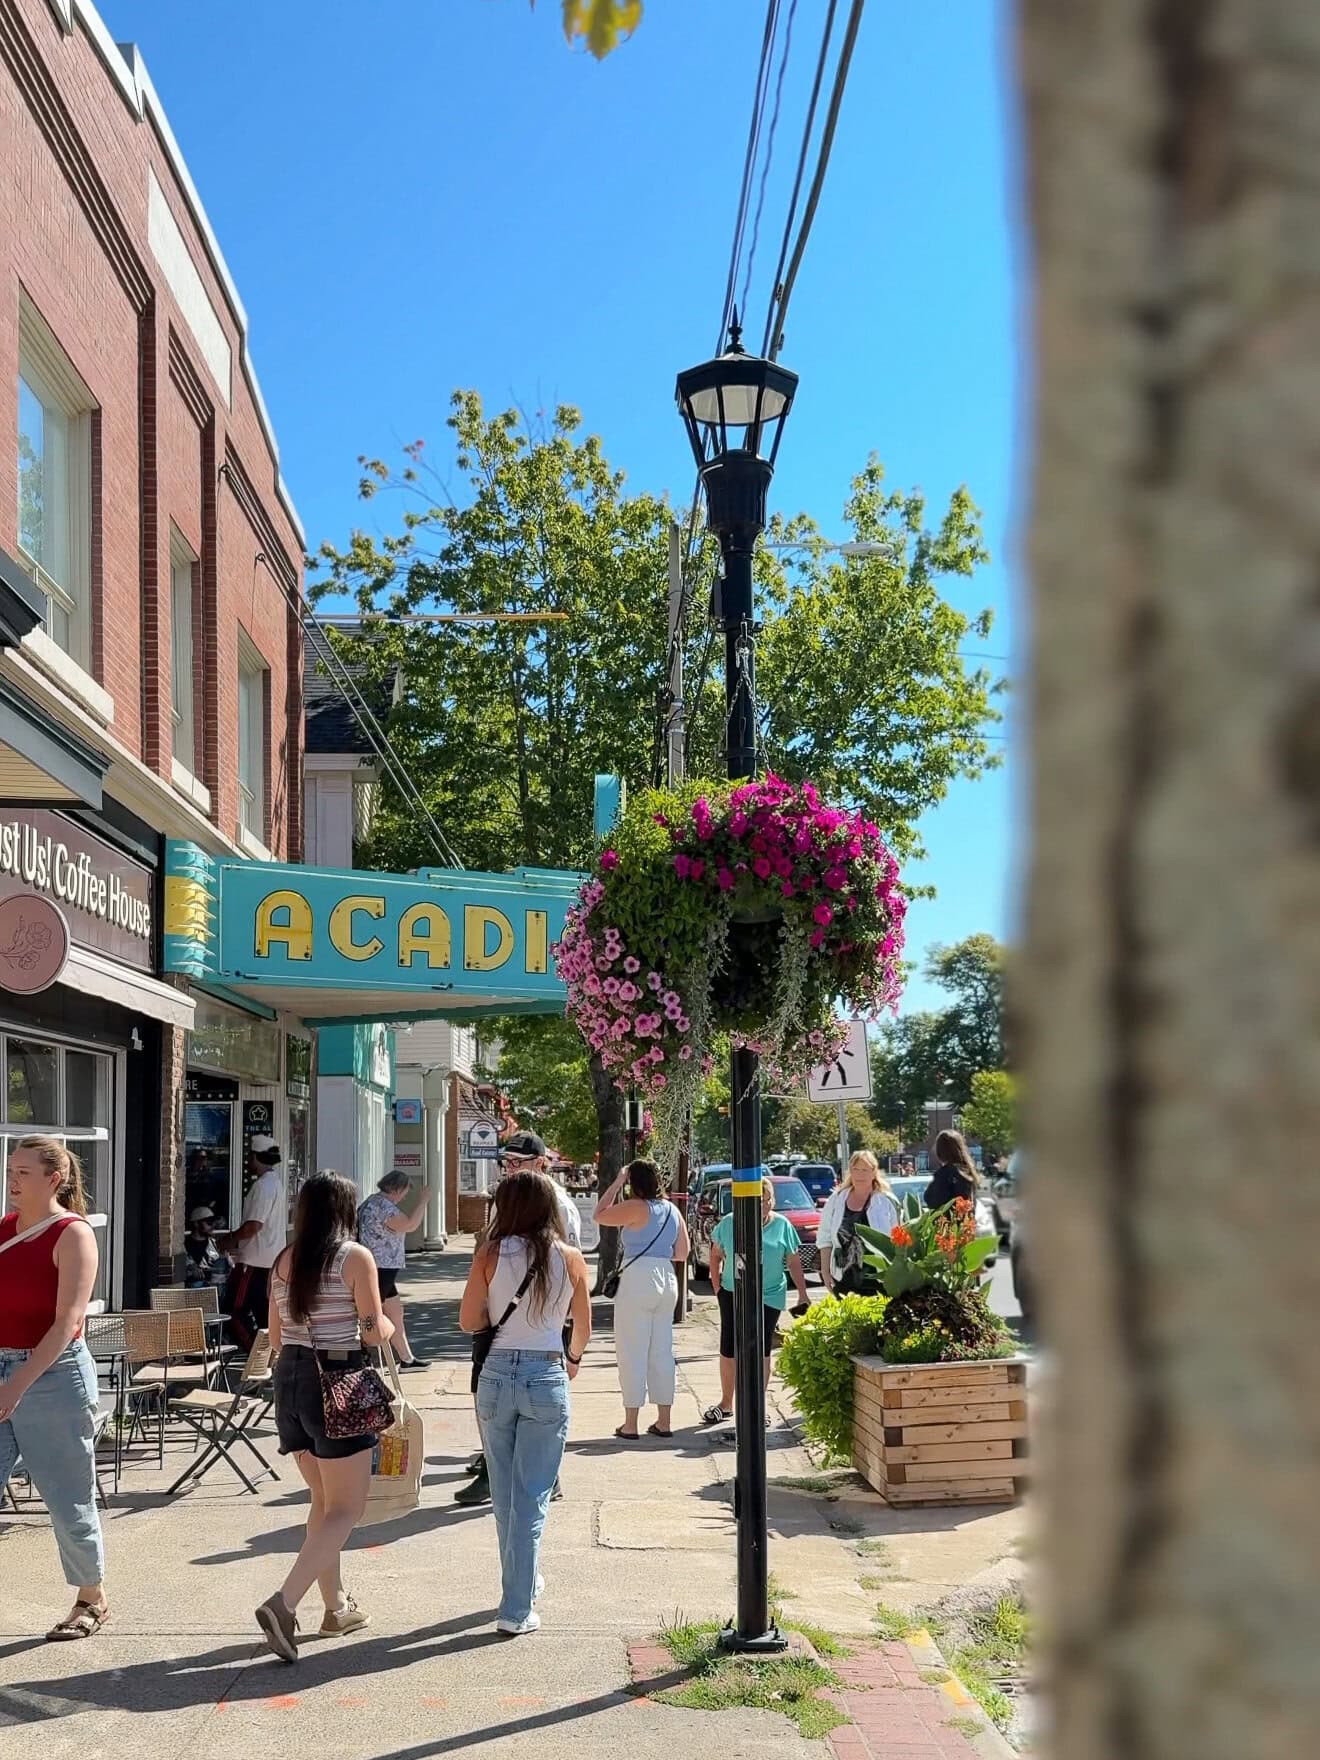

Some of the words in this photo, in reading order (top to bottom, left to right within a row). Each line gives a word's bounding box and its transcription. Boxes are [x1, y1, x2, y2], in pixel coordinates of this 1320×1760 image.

[24, 824, 52, 889] Us!
[55, 843, 107, 916] Coffee
[109, 873, 151, 937] House
[254, 889, 578, 975] ACADI
